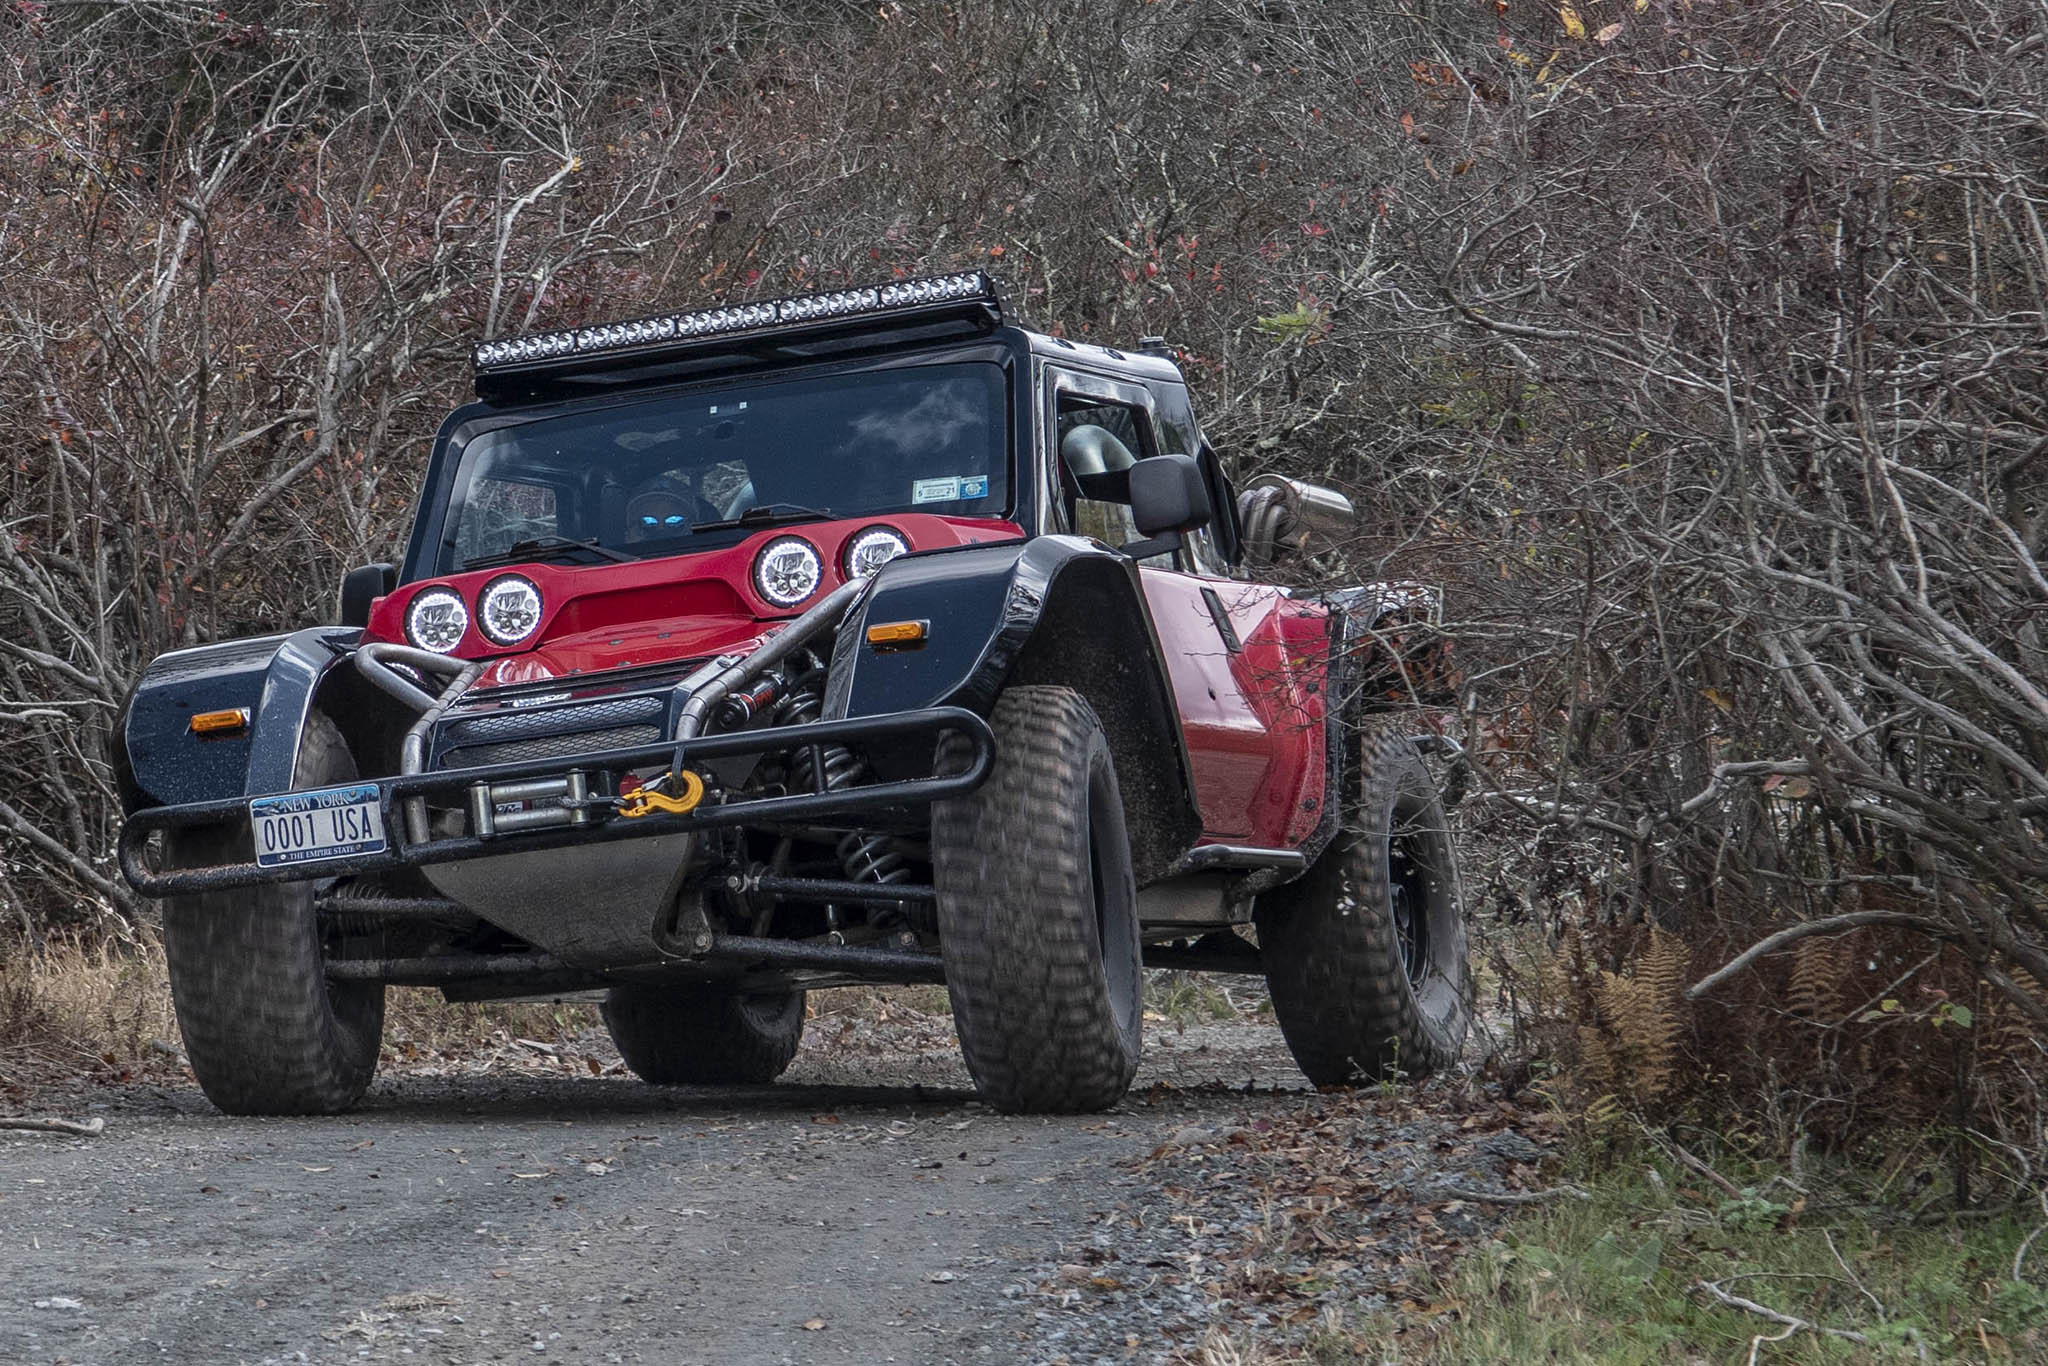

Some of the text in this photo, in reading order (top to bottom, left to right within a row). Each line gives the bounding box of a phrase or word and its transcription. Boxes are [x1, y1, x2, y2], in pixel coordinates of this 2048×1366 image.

[283, 793, 349, 813] NEW YORK
[264, 806, 373, 851] 0001 USA
[289, 847, 355, 860] THE EMPIRE STATE
